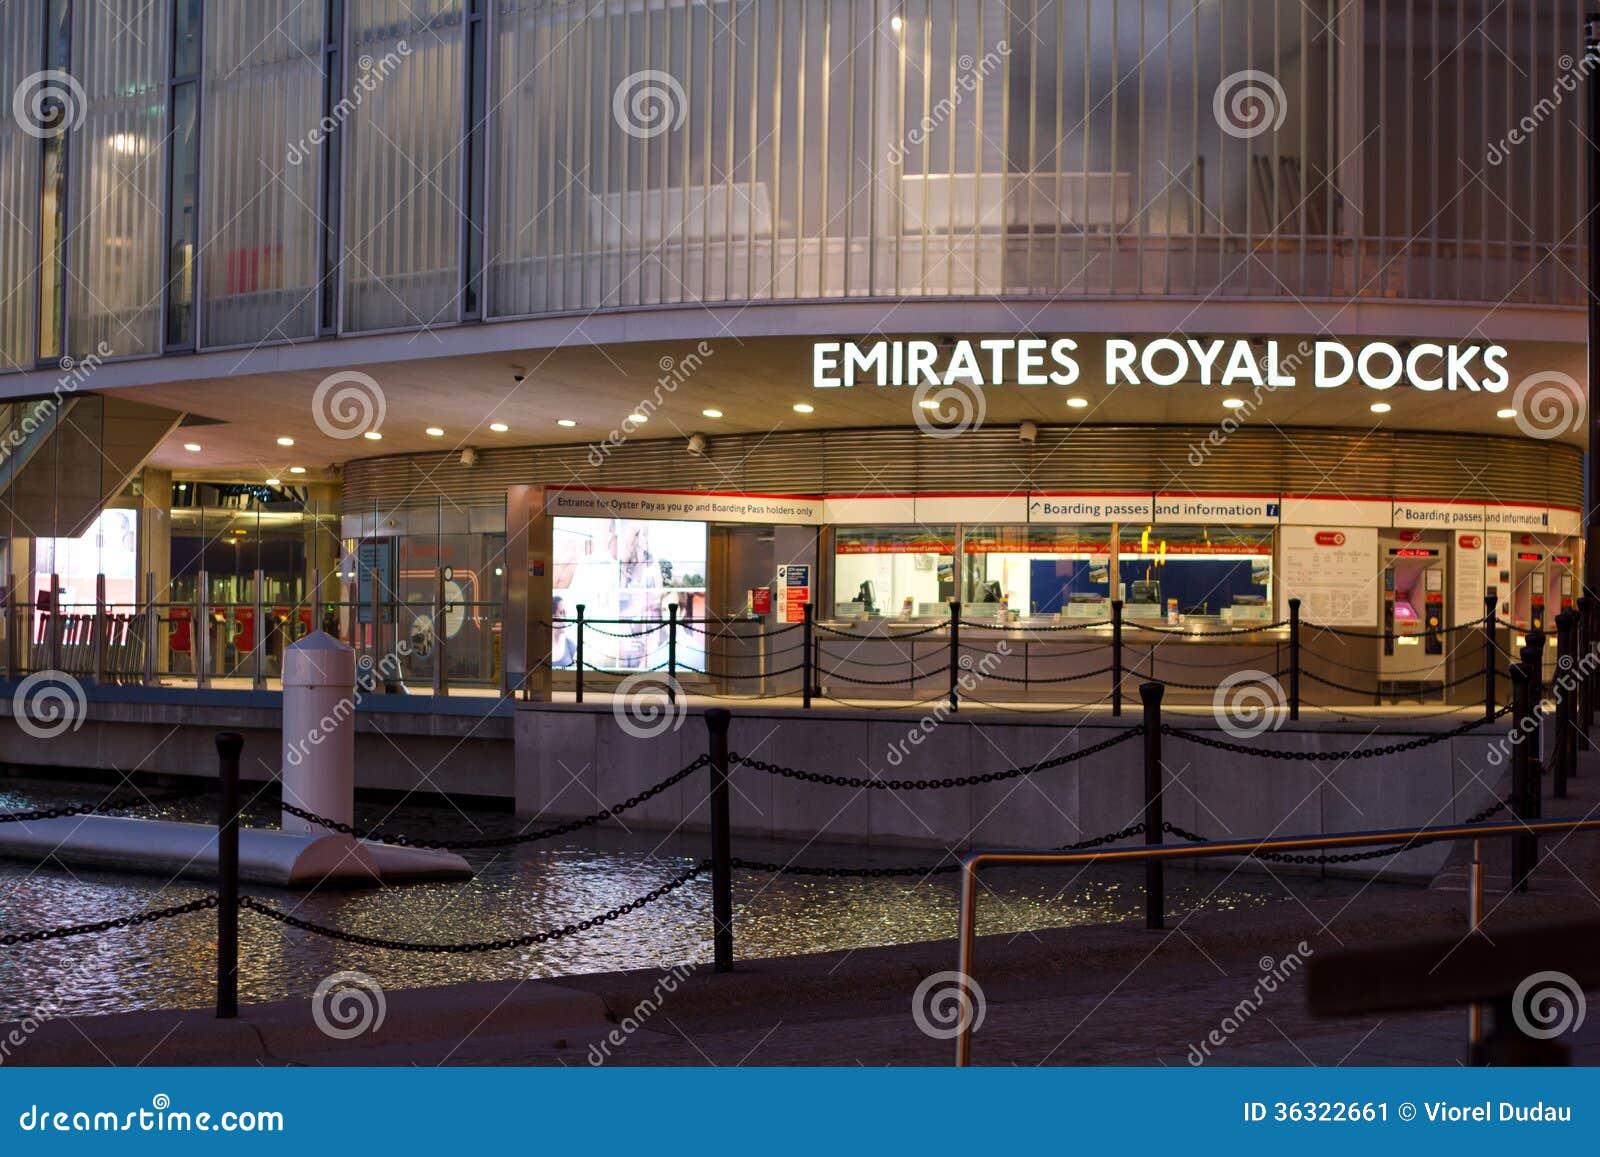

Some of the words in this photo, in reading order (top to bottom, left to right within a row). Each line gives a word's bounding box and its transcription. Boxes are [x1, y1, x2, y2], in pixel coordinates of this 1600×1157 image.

[813, 338, 1080, 388] EMIRATES
[1106, 338, 1296, 387] ROYAL
[1315, 341, 1509, 393] DOCKS
[557, 497, 595, 508] Entrance
[611, 499, 638, 511] Oyster
[641, 500, 654, 512] Pay
[656, 503, 665, 511] as
[667, 503, 682, 513] you
[684, 503, 693, 513] go
[696, 501, 710, 511] and
[712, 502, 746, 515] Boarding
[748, 503, 764, 513] Pass
[766, 504, 795, 515] holders
[796, 505, 812, 517] only
[1043, 503, 1100, 516] Boarding
[1105, 506, 1149, 516] passes
[1155, 504, 1180, 515] and
[1184, 503, 1262, 515] information
[1405, 509, 1450, 522] Boarding
[1453, 512, 1482, 524] passes
[1486, 512, 1500, 523] and
[1502, 512, 1541, 525] information
